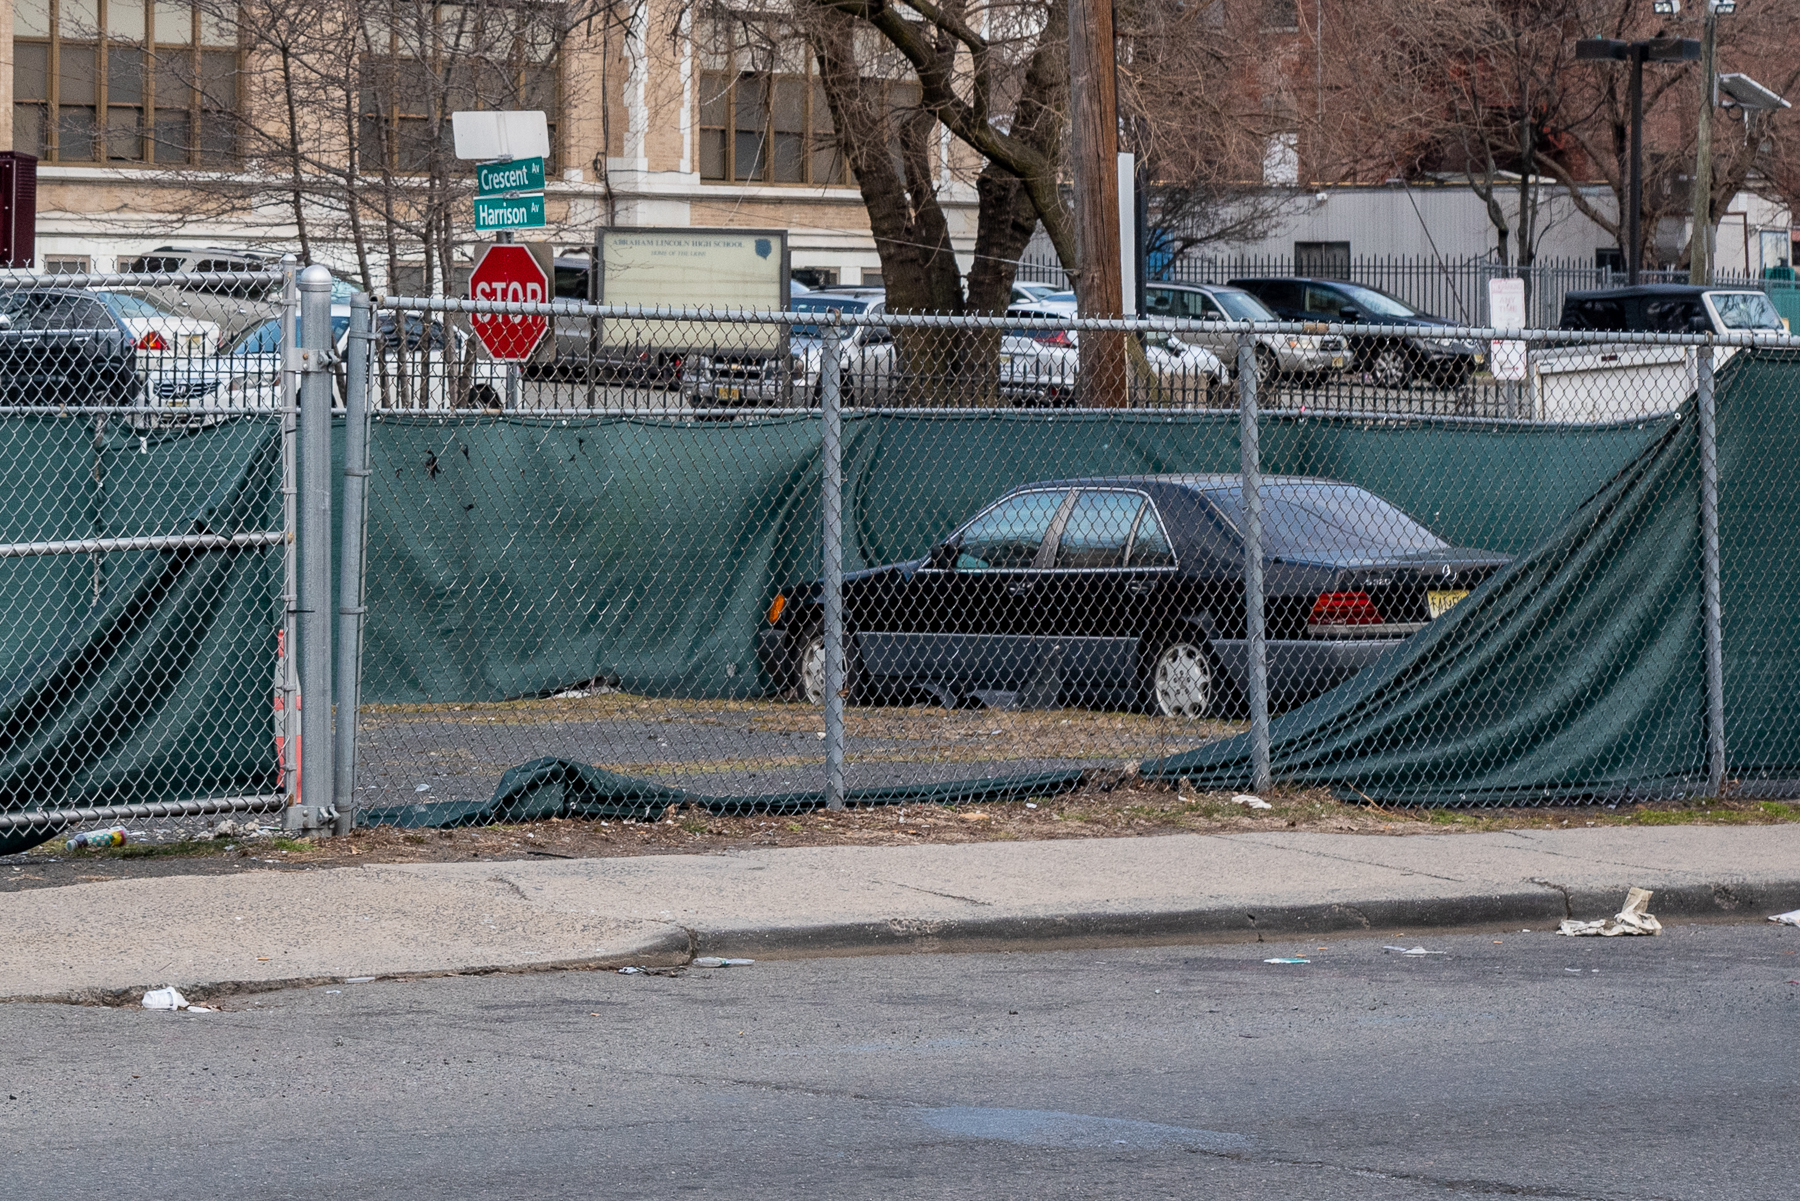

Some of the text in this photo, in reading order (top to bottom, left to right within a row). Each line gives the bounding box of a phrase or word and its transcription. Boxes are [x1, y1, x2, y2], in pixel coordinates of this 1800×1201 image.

[481, 162, 540, 190] Crescent Av
[479, 202, 540, 226] Harrison Av
[655, 239, 690, 247] LINCOLN
[476, 281, 542, 324] STOP
